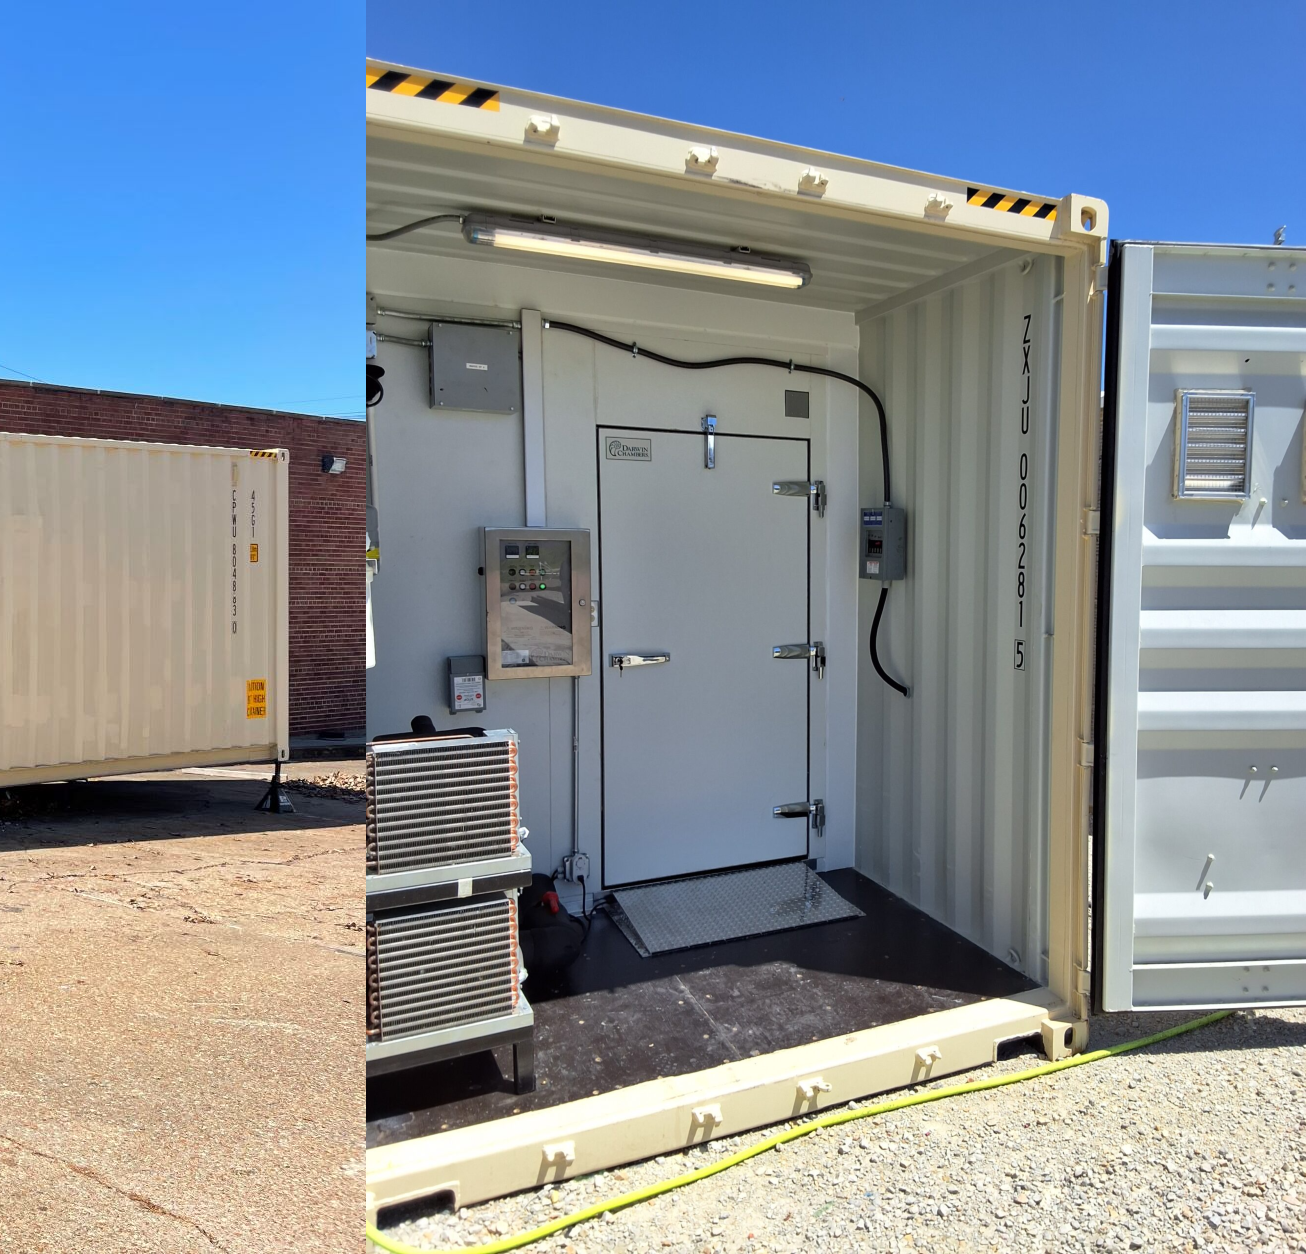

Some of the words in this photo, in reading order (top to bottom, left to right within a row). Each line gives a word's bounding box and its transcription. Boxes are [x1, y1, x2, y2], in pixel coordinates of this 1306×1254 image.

[1021, 314, 1032, 434] ZXJU
[617, 450, 650, 458] CHAMBERS
[622, 444, 649, 453] DARWIN
[1017, 453, 1028, 627] 006281
